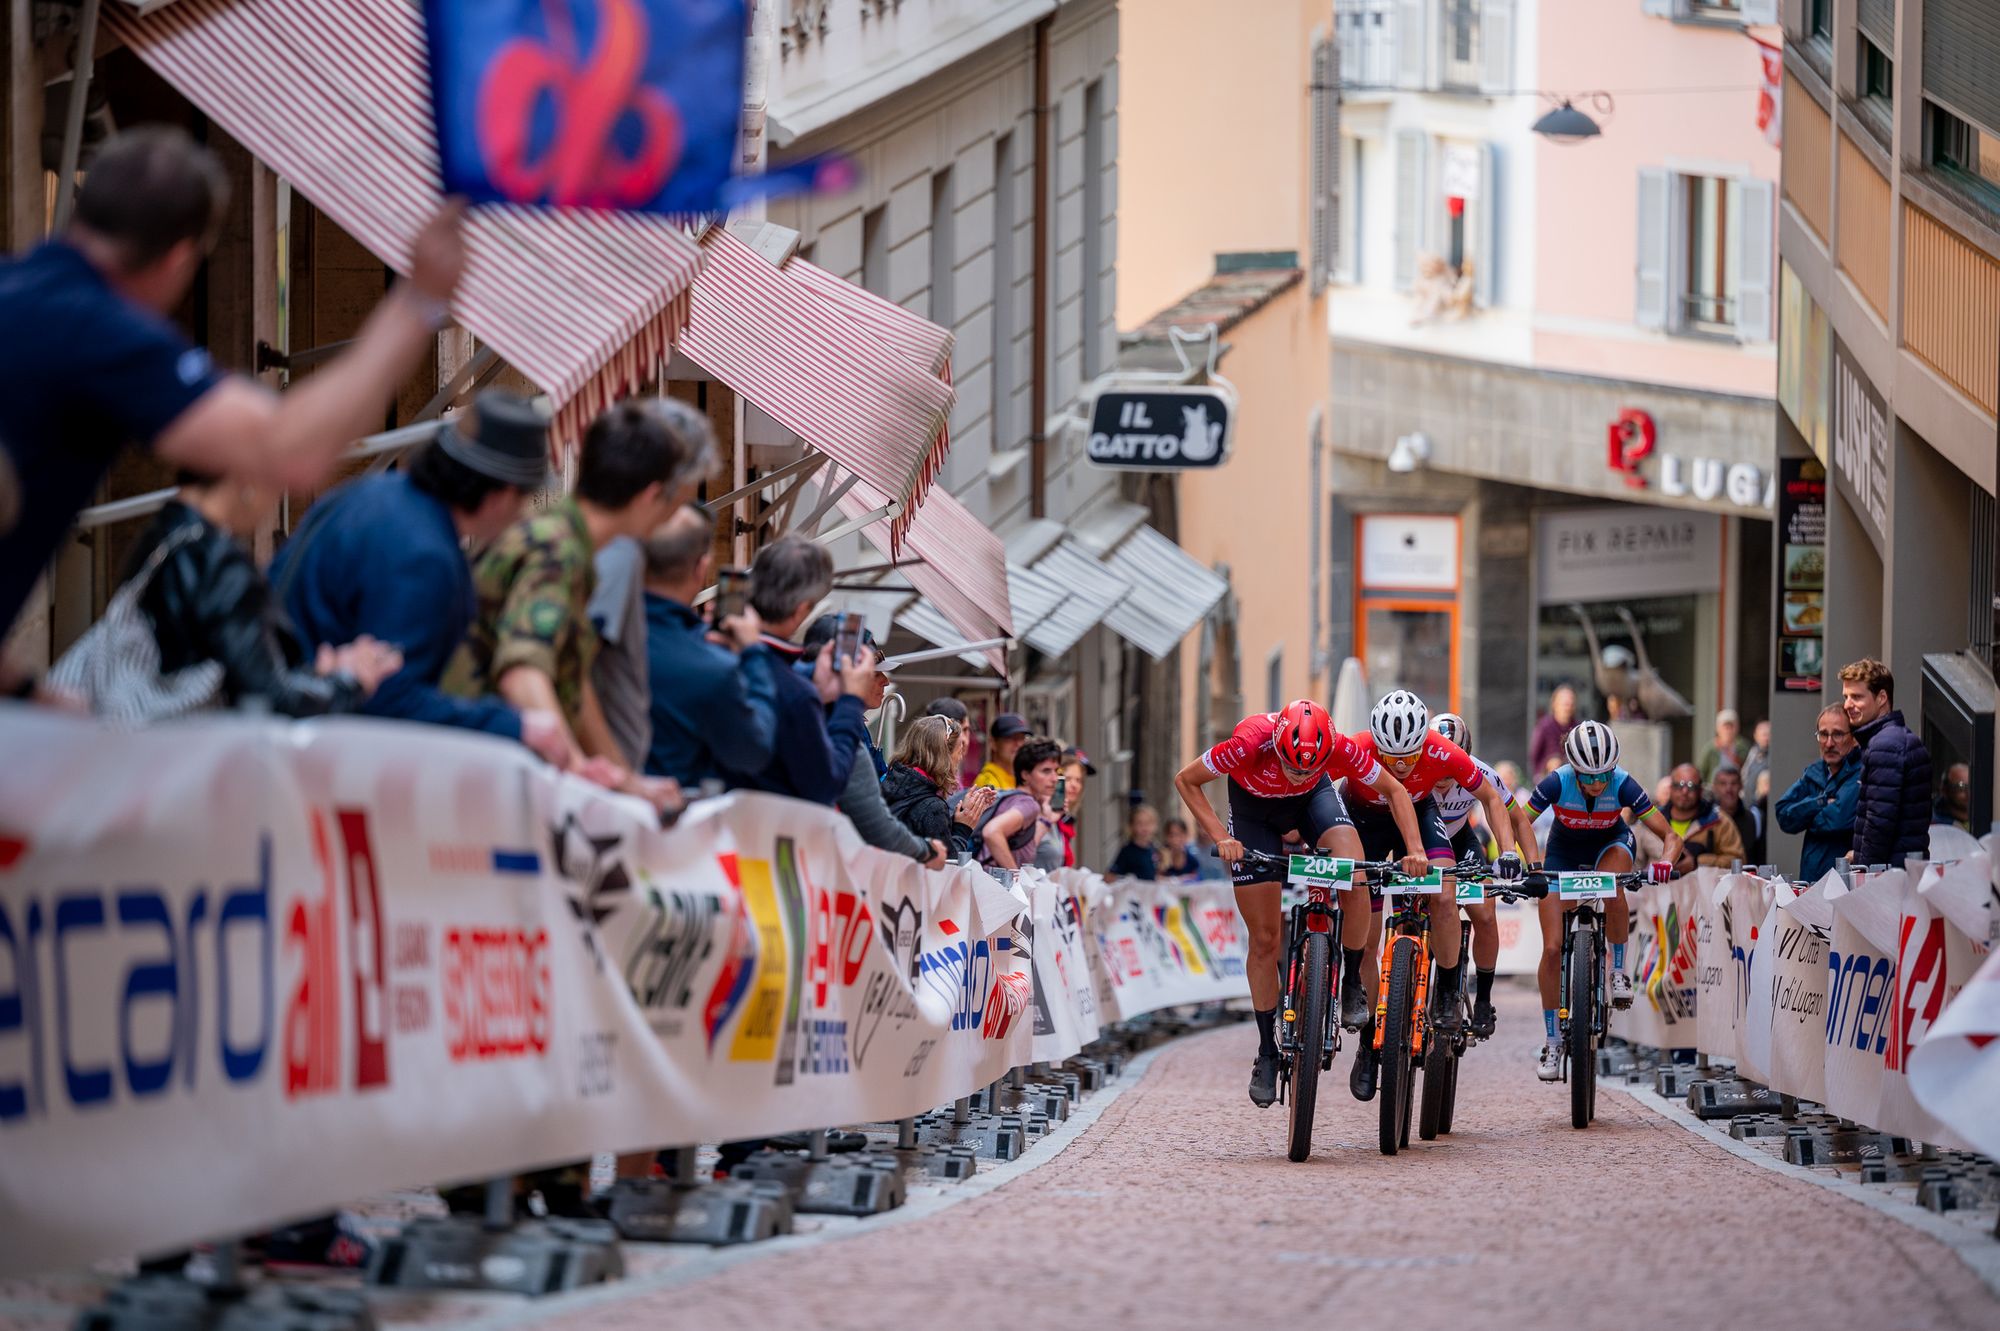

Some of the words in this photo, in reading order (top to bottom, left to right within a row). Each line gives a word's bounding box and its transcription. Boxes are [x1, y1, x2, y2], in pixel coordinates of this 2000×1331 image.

[1120, 401, 1153, 428] IL
[1087, 432, 1180, 460] GATTO
[1836, 353, 1871, 513] LUSH
[1556, 530, 1597, 554] FIX
[1607, 521, 1696, 552] REPAIR
[1427, 745, 1450, 761] Liv
[1303, 857, 1339, 876] 204
[1572, 877, 1603, 890] 203
[1791, 979, 1823, 1024] Lugano
